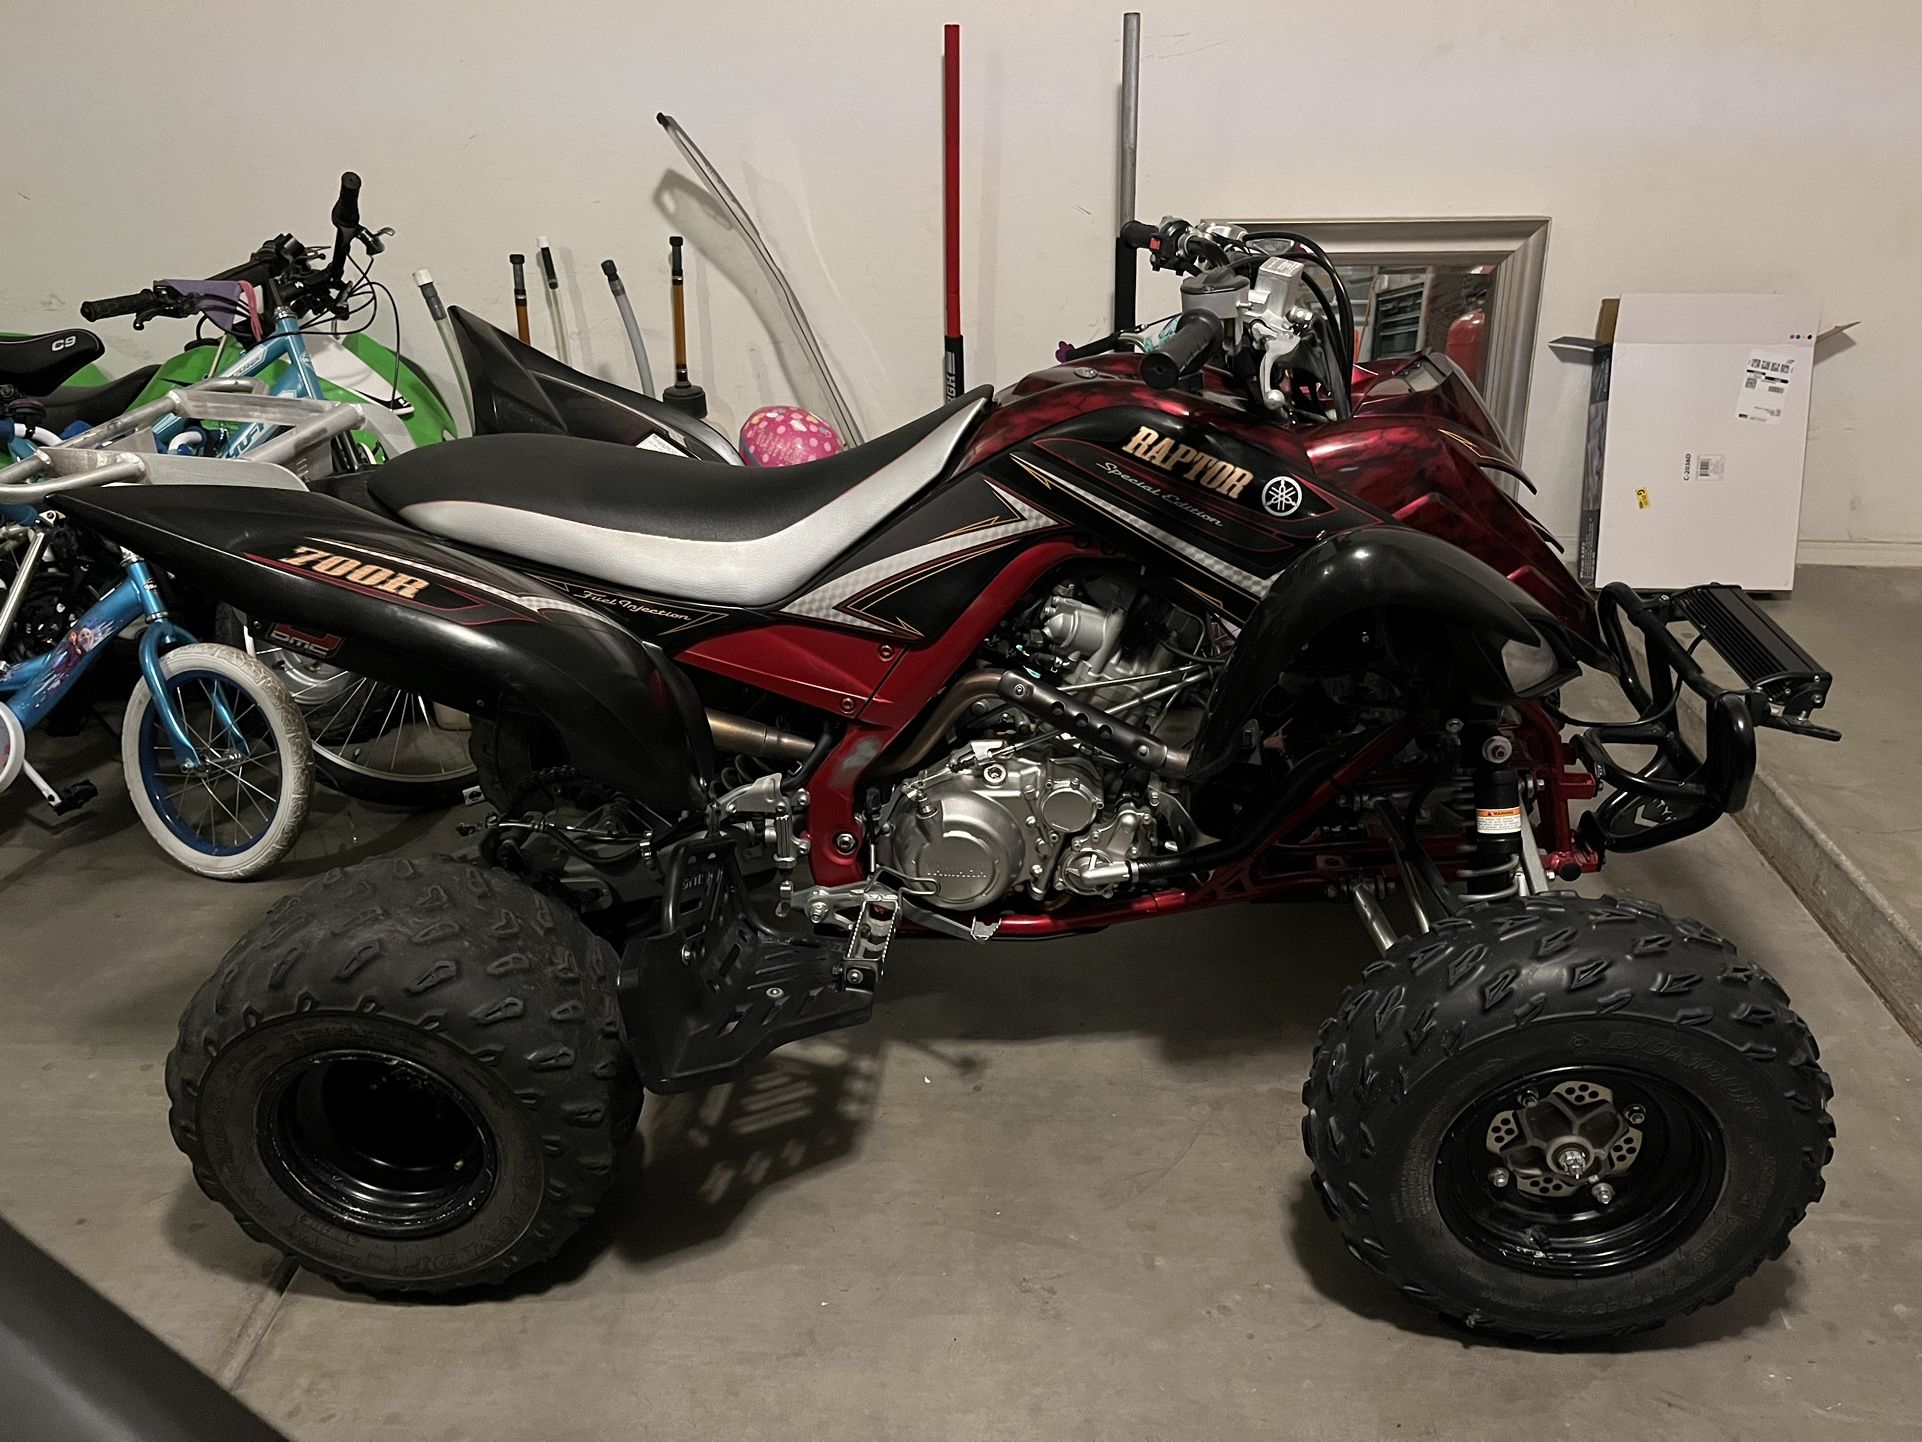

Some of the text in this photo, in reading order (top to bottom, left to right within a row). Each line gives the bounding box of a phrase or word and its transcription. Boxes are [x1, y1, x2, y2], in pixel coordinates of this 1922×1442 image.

[51, 335, 76, 352] C9
[1122, 425, 1255, 499] RAPTOR
[1096, 461, 1224, 527] Special Edition
[277, 545, 430, 600] 700R
[573, 590, 692, 621] Fuel Injection
